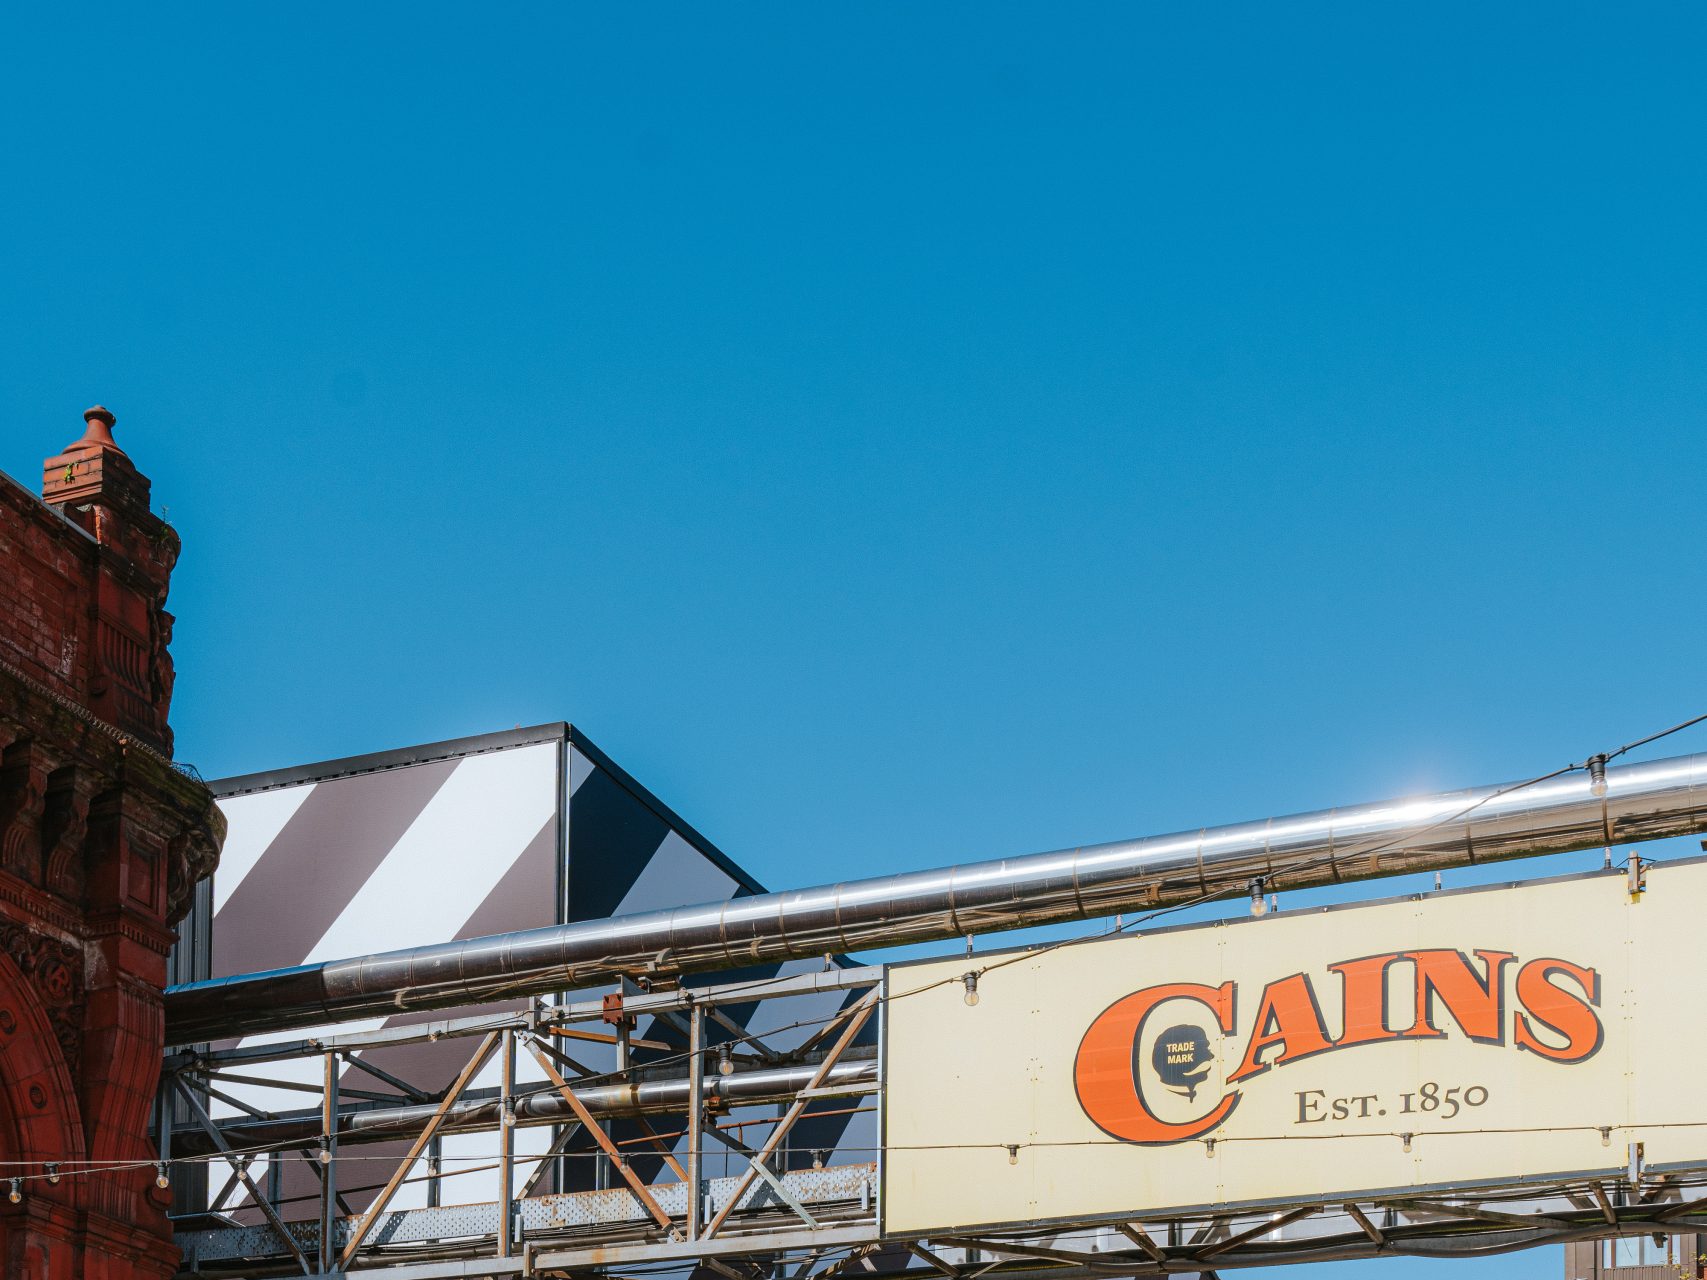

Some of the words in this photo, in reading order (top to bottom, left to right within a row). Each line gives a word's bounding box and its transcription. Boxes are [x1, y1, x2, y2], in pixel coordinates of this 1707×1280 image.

[1072, 948, 1605, 1147] CAINS
[1166, 1041, 1195, 1053] TRADE
[1167, 1053, 1194, 1065] MARK
[1399, 1082, 1489, 1119] 1850
